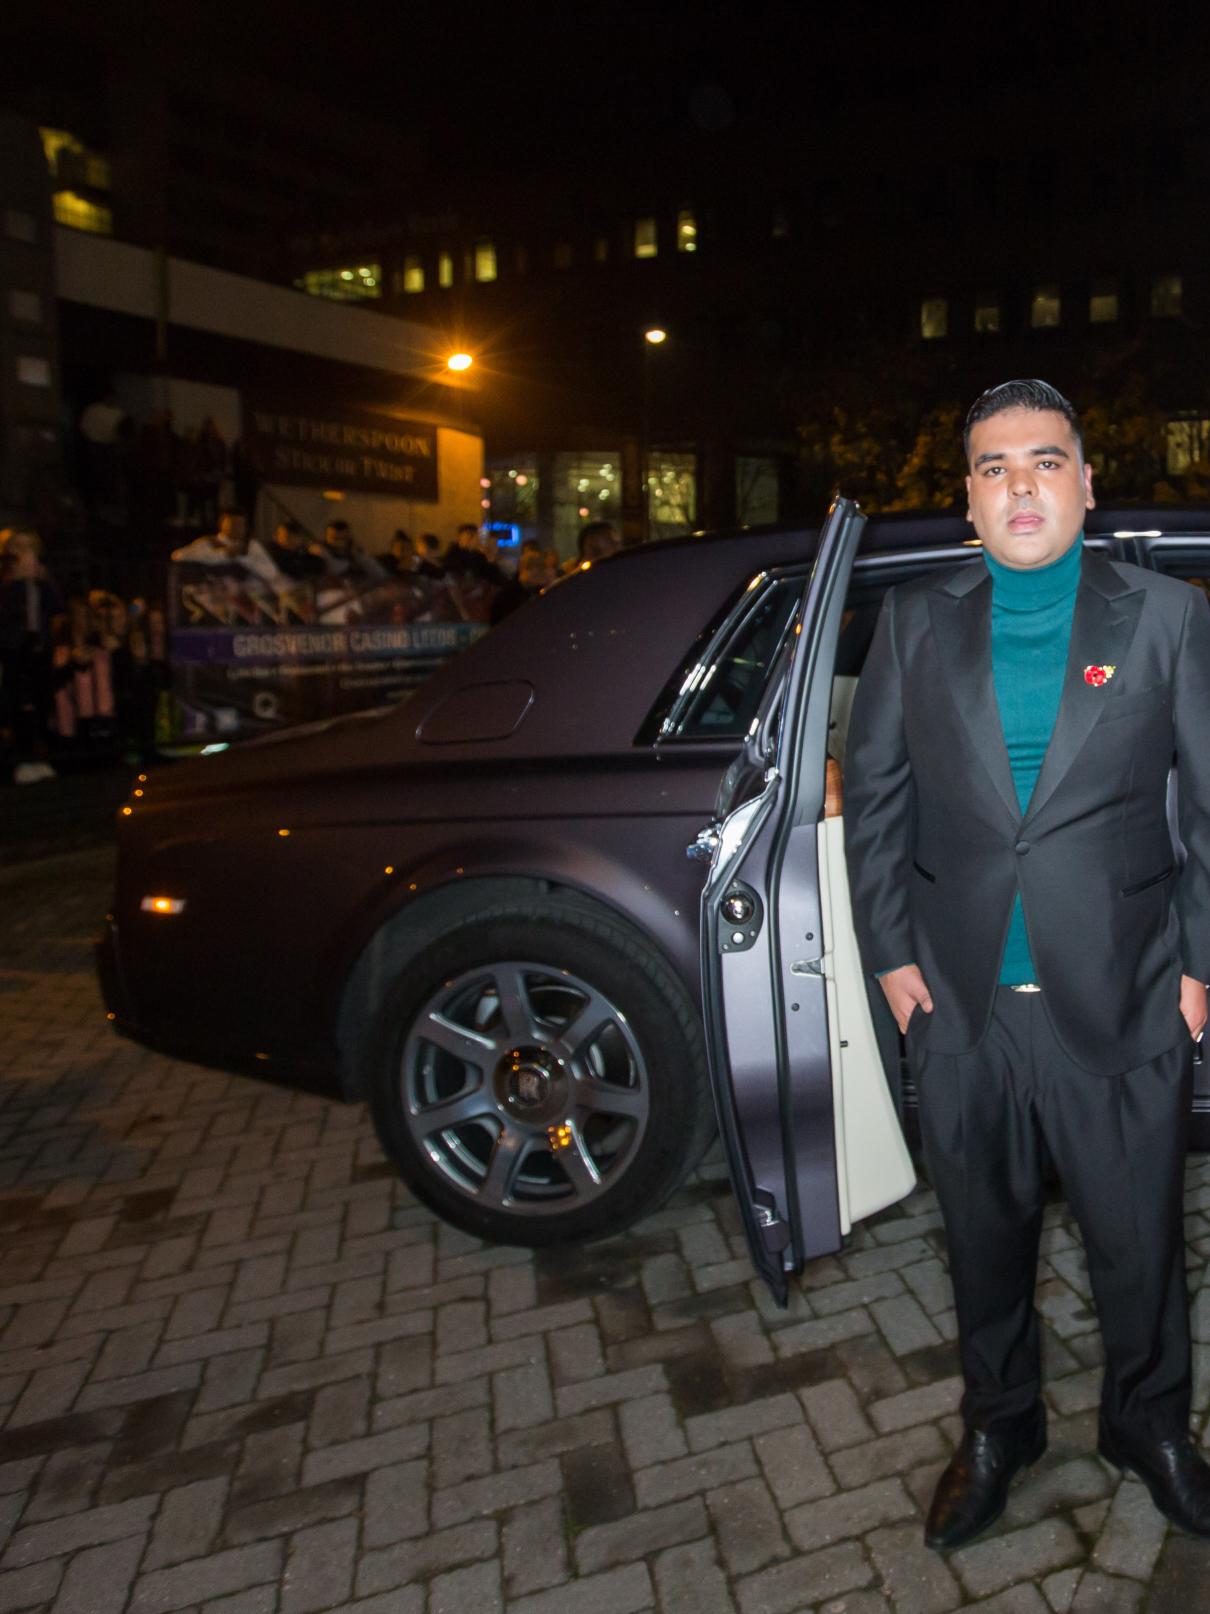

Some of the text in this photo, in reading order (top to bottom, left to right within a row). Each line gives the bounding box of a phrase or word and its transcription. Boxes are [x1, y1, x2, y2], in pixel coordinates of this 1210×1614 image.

[255, 412, 431, 457] WETHERSPOON
[233, 631, 346, 657] GROSVENOR
[350, 629, 408, 652] CASINO
